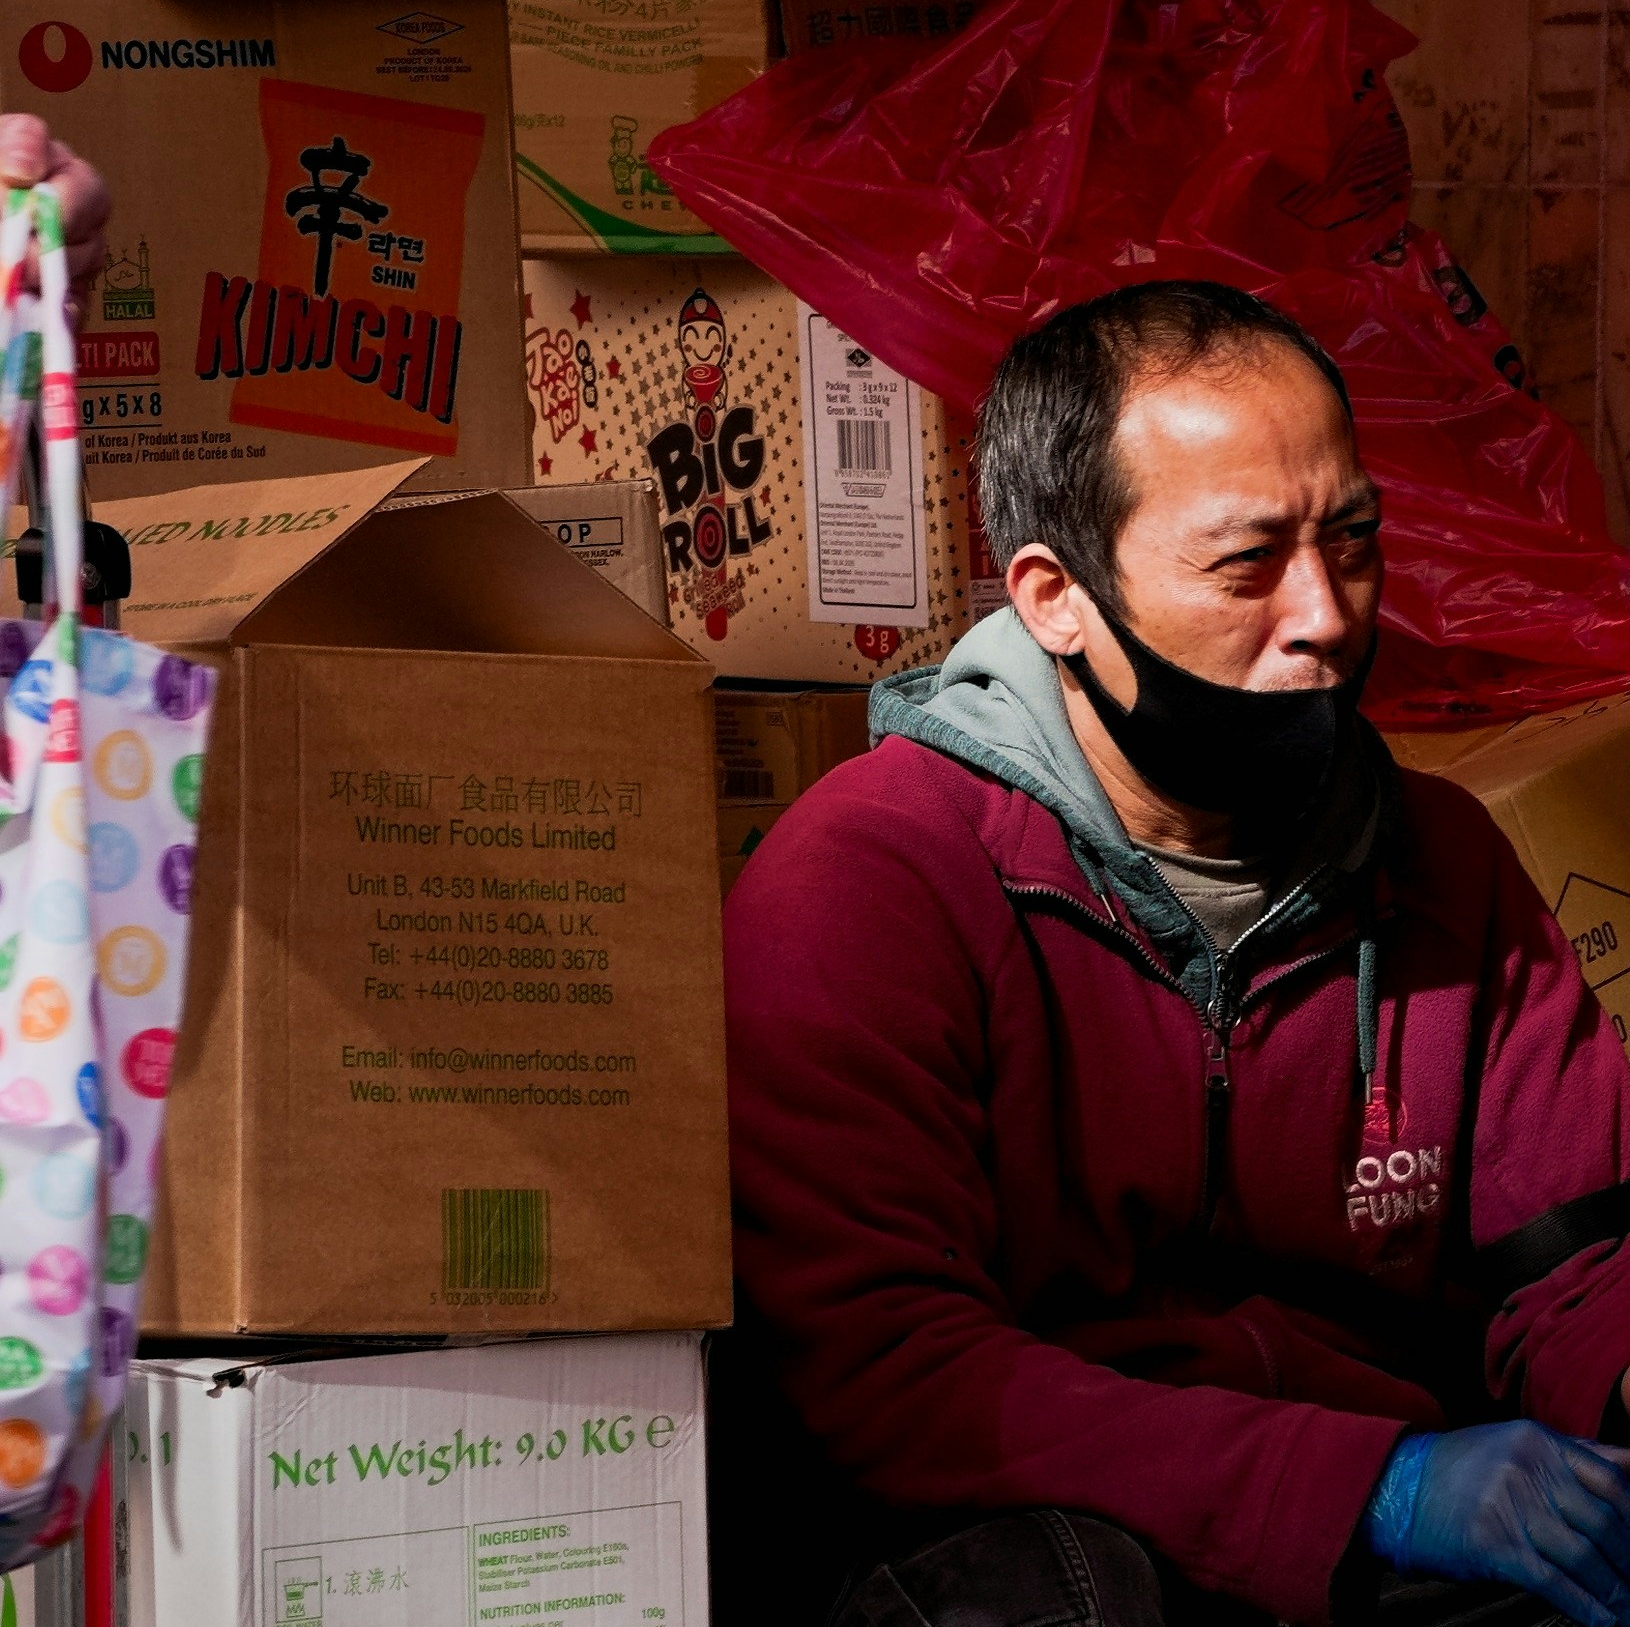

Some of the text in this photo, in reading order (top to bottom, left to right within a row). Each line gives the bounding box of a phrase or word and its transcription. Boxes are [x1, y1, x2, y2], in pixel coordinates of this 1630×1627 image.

[583, 23, 615, 40] RICE
[101, 38, 276, 70] NONGSHIM
[285, 136, 388, 296] 辛
[368, 232, 424, 262] 라면
[371, 266, 416, 290] SHIN
[105, 303, 153, 319] HALAL
[105, 341, 155, 367] PACK
[195, 271, 462, 424] KIMCHI
[525, 327, 573, 390] Tao
[98, 434, 129, 448] Korea
[138, 432, 178, 447] Produkt
[180, 432, 199, 444] aus
[201, 430, 231, 443] Korea
[102, 450, 133, 463] Korea
[142, 447, 179, 462] Produit
[182, 447, 195, 460] de
[198, 446, 228, 460] Corée
[230, 446, 244, 458] du
[246, 445, 266, 458] Sud
[647, 405, 765, 516] BIG
[185, 504, 351, 543] NOODLES
[662, 496, 772, 572] ROLL
[355, 816, 616, 851] Winner Foods Limited
[348, 873, 626, 904] Unit B, 43-53 Markfield Road
[376, 908, 599, 938] London N15 4QA, U.K.
[367, 942, 609, 972] Tel: +44(0)20-8880 3678
[363, 977, 614, 1007] Fax: +44(0)20-8880 3885
[342, 1045, 637, 1074] Email: info@winnerfoods.com
[349, 1080, 631, 1106] Web: www.winnerfoods.com
[1346, 1182, 1441, 1232] FUNG
[267, 1414, 635, 1491] Net Weight: 9.0 KG
[479, 1524, 571, 1547] INGREDIENTS:
[479, 1592, 626, 1620] NUTRITION INFORMATION:
